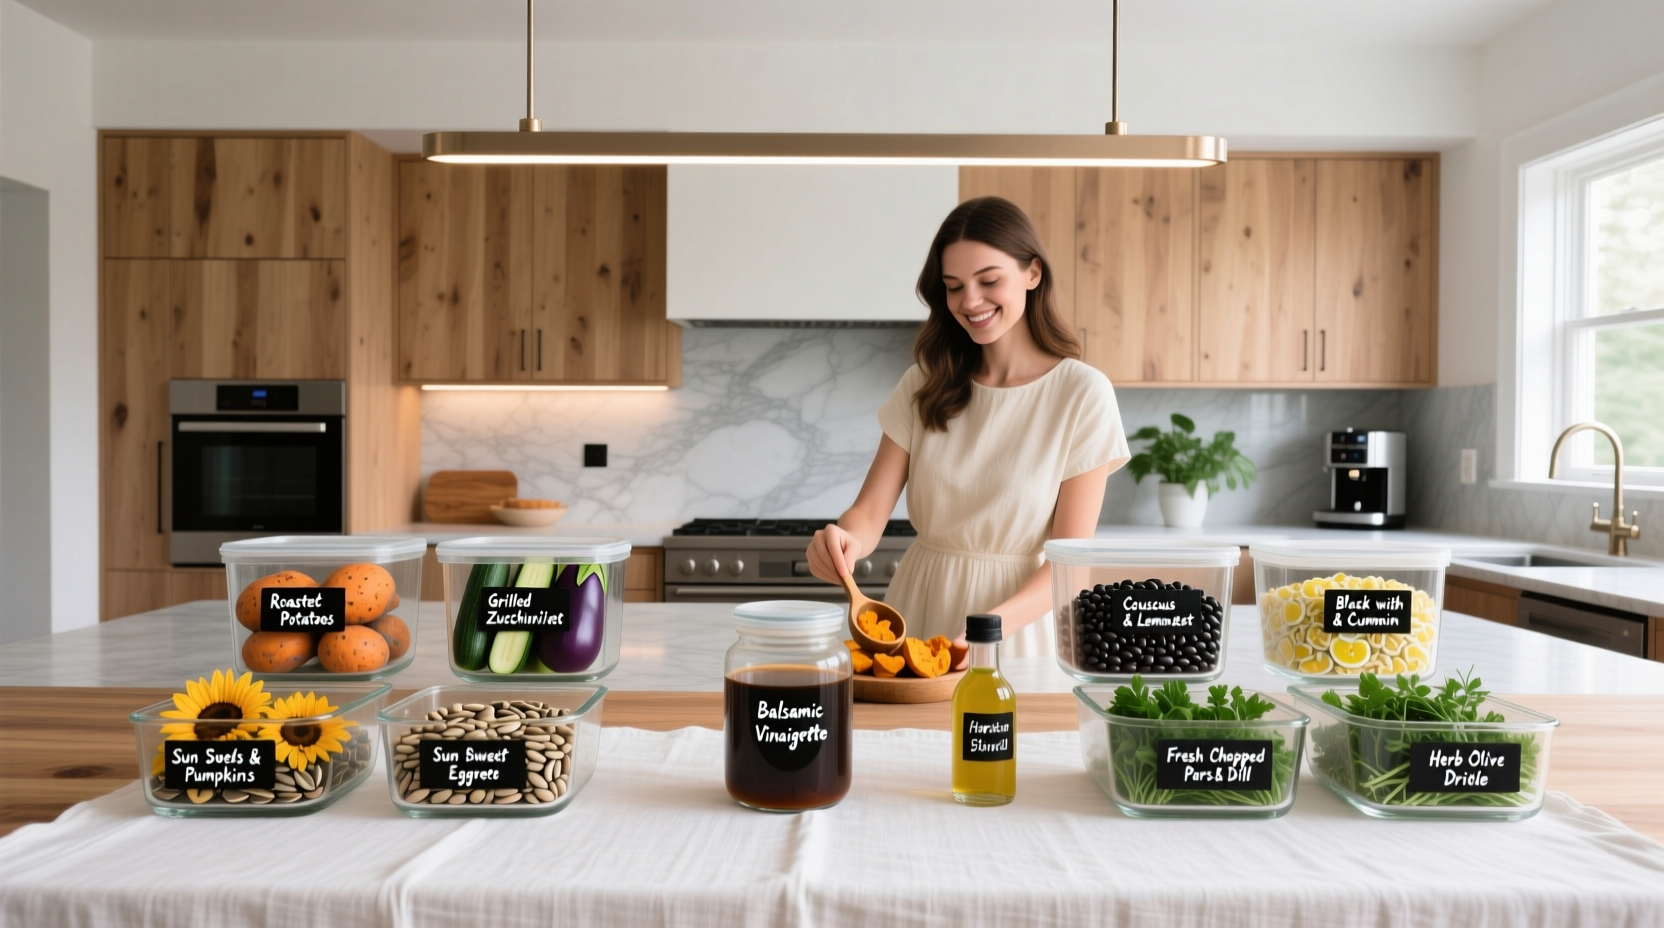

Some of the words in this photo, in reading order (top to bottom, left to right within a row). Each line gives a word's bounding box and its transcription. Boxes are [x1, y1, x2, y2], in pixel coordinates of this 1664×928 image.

[488, 592, 532, 608] Grilled
[1375, 594, 1404, 611] with
[1122, 612, 1133, 627] &
[1332, 612, 1343, 627] &
[757, 699, 824, 720] Balsamic
[171, 747, 199, 765] Sun
[248, 747, 262, 766] &
[432, 746, 459, 763] Sun
[1166, 746, 1204, 763] Fresh
[1209, 746, 1266, 771] Chopped
[1429, 749, 1464, 767] Herb
[1467, 749, 1505, 767] Olive
[185, 765, 256, 788] Pumpkins
[1227, 764, 1252, 782] Dill
